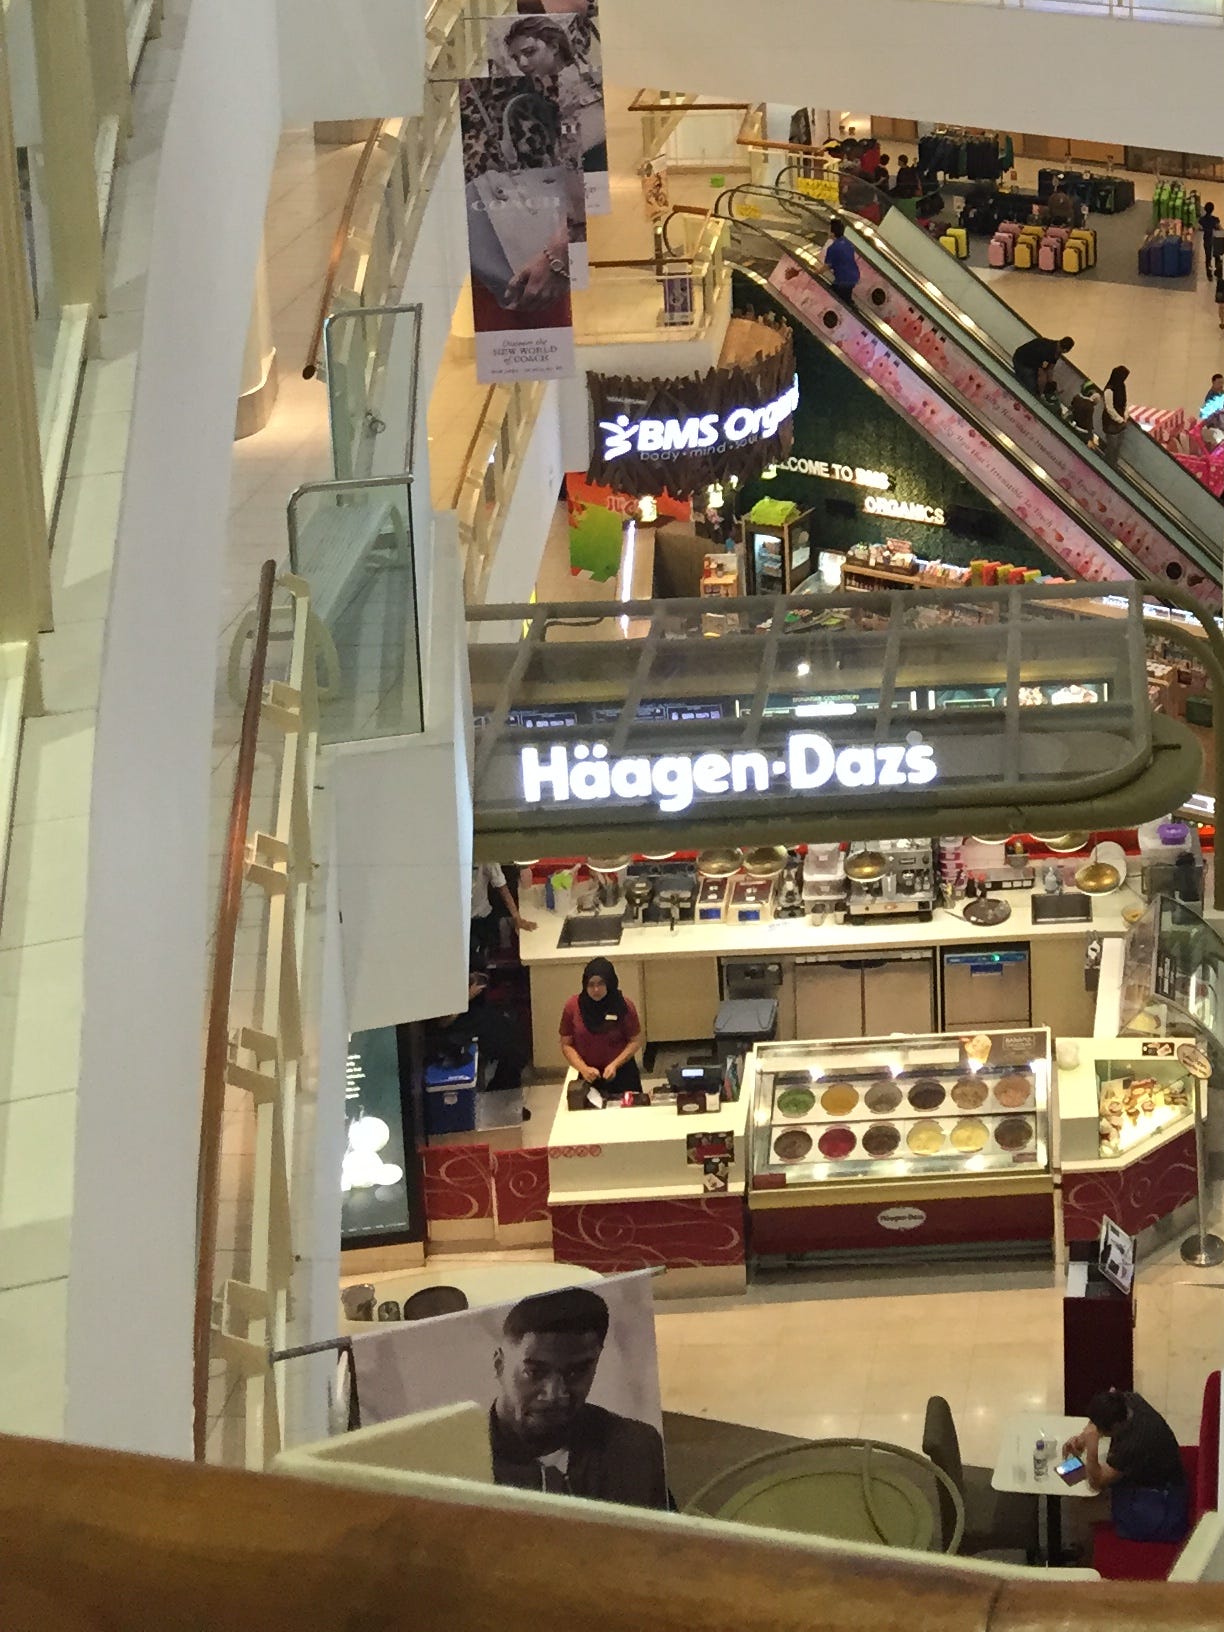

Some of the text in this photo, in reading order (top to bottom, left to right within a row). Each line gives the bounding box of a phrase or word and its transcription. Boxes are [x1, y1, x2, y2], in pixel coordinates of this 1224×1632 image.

[520, 345, 558, 354] WORLD
[637, 414, 719, 451] BMS
[640, 450, 679, 462] body
[690, 444, 727, 458] mind
[831, 463, 853, 482] TO
[864, 496, 945, 525] ORGANICS
